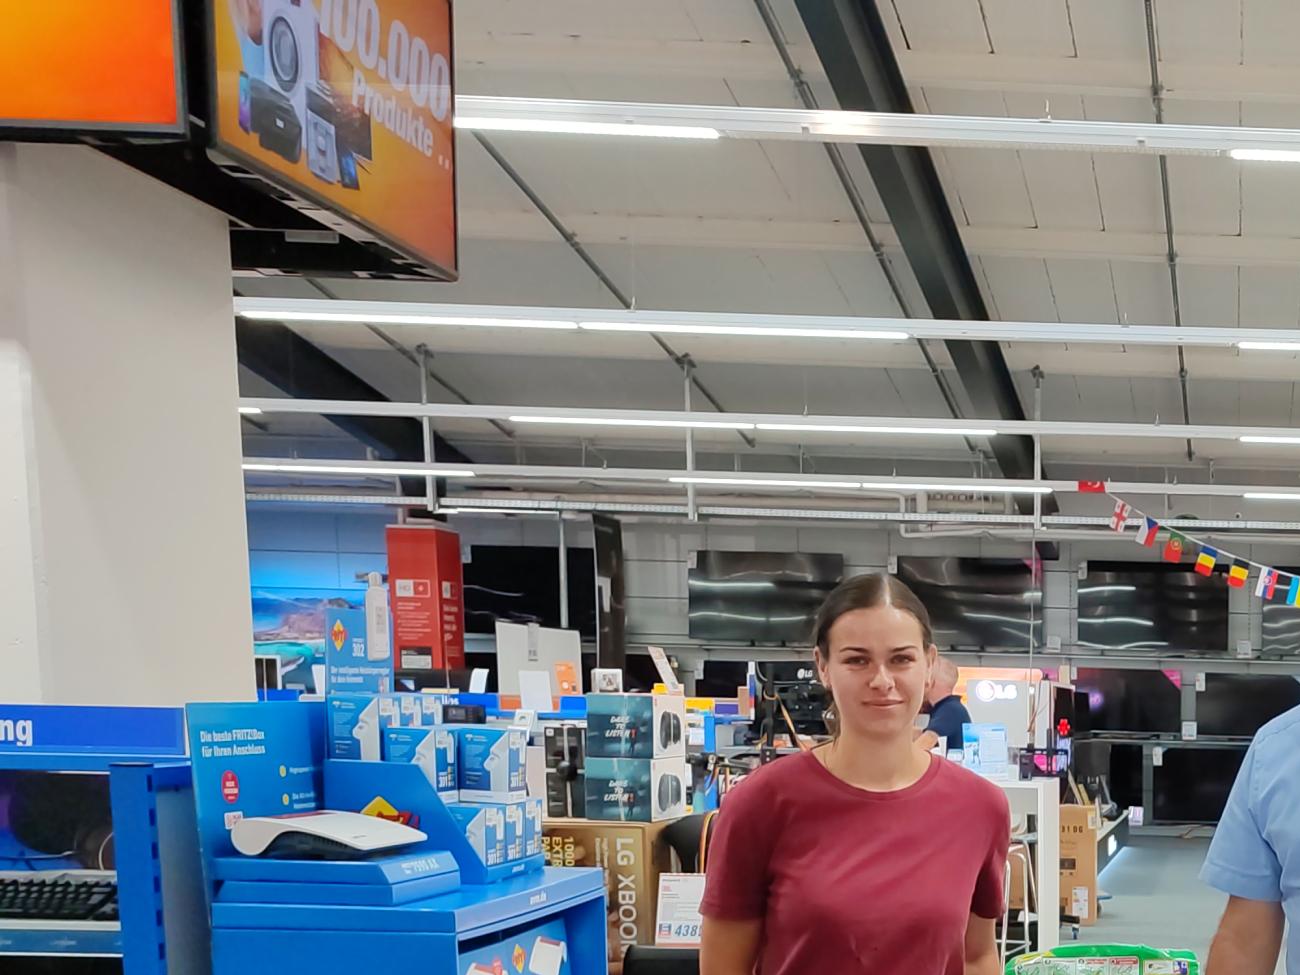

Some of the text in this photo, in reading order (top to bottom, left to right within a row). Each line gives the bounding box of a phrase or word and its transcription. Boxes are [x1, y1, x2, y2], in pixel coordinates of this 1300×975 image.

[353, 71, 433, 157] Produkte
[200, 731, 212, 743] Die
[616, 838, 636, 866] LG
